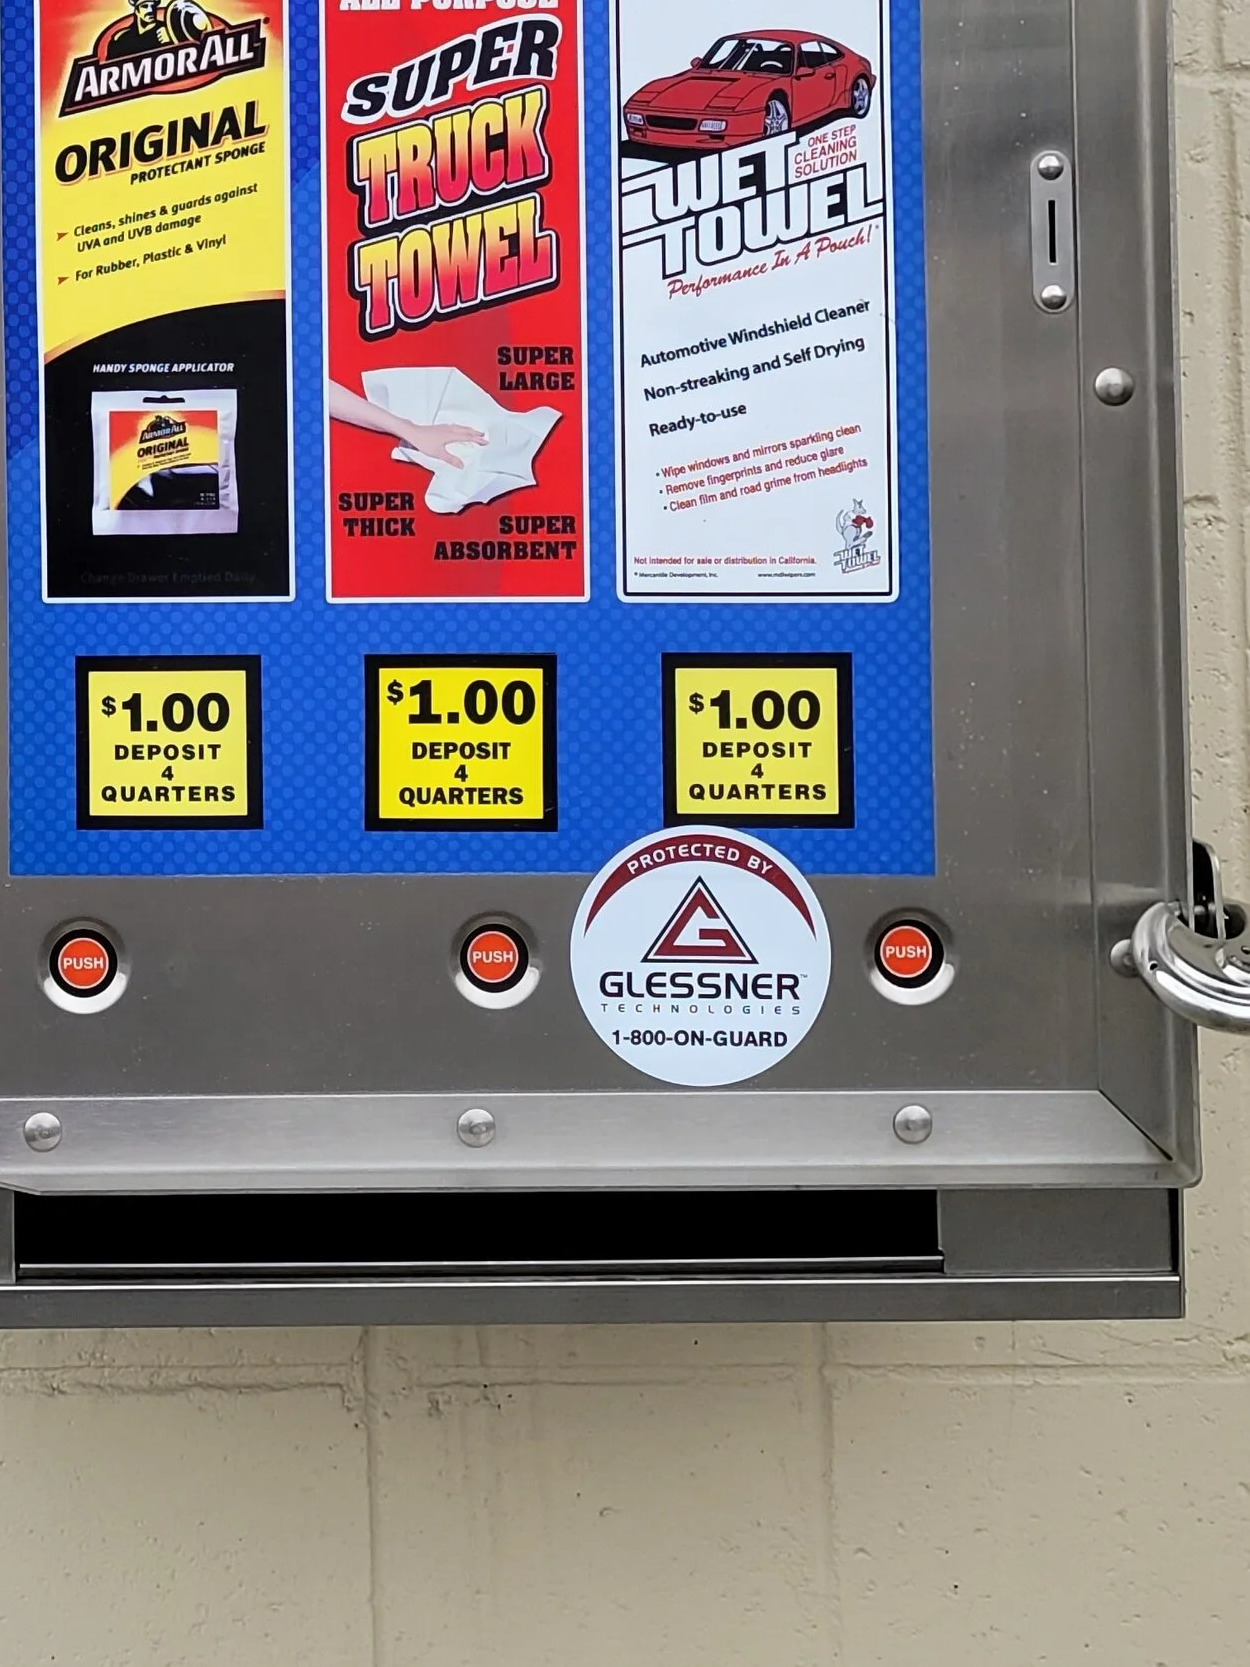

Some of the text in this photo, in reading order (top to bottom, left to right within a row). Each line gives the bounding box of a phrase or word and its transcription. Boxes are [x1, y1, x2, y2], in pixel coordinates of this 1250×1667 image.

[73, 31, 255, 102] ARMOR ALL
[344, 15, 561, 122] SUPER
[54, 99, 269, 185] ORIGINAL
[807, 124, 857, 148] ONE STEP
[130, 141, 266, 185] PROTECTANT SPONGE
[354, 87, 548, 229] TRUCK
[793, 136, 858, 166] CLEANING
[793, 149, 858, 180] SOLUTION
[622, 130, 800, 222] WET
[74, 182, 258, 238] Cleans, shines & guards against
[622, 161, 884, 280] TOWEL
[77, 213, 202, 253] UVA and UVB damage
[75, 233, 227, 282] For Rubber, Plastic & Vinyl
[357, 197, 553, 331] TOWEL
[666, 224, 873, 299] Performance In A Pouch!
[640, 299, 871, 368] Automotive Windshield Cleaner
[92, 361, 235, 374] HANDY SPONGE APPLICATOR
[497, 346, 575, 366] SUPER
[643, 335, 866, 401] Non-streaking and Self Drying
[499, 371, 576, 391] LARGE
[648, 402, 748, 437] Ready-to-use
[137, 437, 190, 458] ORIGINAL
[661, 423, 862, 480] Wipe windows and mirrors sparkling clean
[665, 445, 844, 495] Remove fingerprints and reduce glare
[669, 456, 868, 512] Clean film and road grime from headlights
[338, 492, 415, 512] SUPER
[342, 517, 416, 537] THICK
[499, 515, 576, 535] SUPER
[433, 540, 578, 560] ABSORBENT
[634, 556, 648, 565] Not
[649, 556, 682, 565] intended
[684, 556, 696, 565] for
[697, 556, 712, 565] sale
[724, 556, 768, 565] distribution
[778, 555, 817, 565] California.
[101, 692, 230, 733] $1.00
[386, 679, 537, 726] $1.00
[688, 689, 821, 730] $1.00
[114, 744, 221, 761] DEPOSIT
[411, 741, 511, 760] DEPOSIT
[701, 741, 812, 758] DEPOSIT
[161, 765, 174, 781] 4
[453, 764, 468, 782] 4
[750, 763, 764, 779] 4
[101, 785, 236, 802] QUARTERS
[399, 787, 524, 806] QUARTERS
[688, 783, 827, 801] QUARTERS
[626, 843, 774, 876] PROTECTED BY
[63, 957, 104, 971] PUSH
[472, 950, 514, 964] PUSH
[885, 945, 927, 959] PUSH
[599, 971, 801, 1000] GLESSNER
[600, 1003, 802, 1016] TECHNOLOGIES
[611, 1029, 789, 1048] 1-800-ON-GUARD
